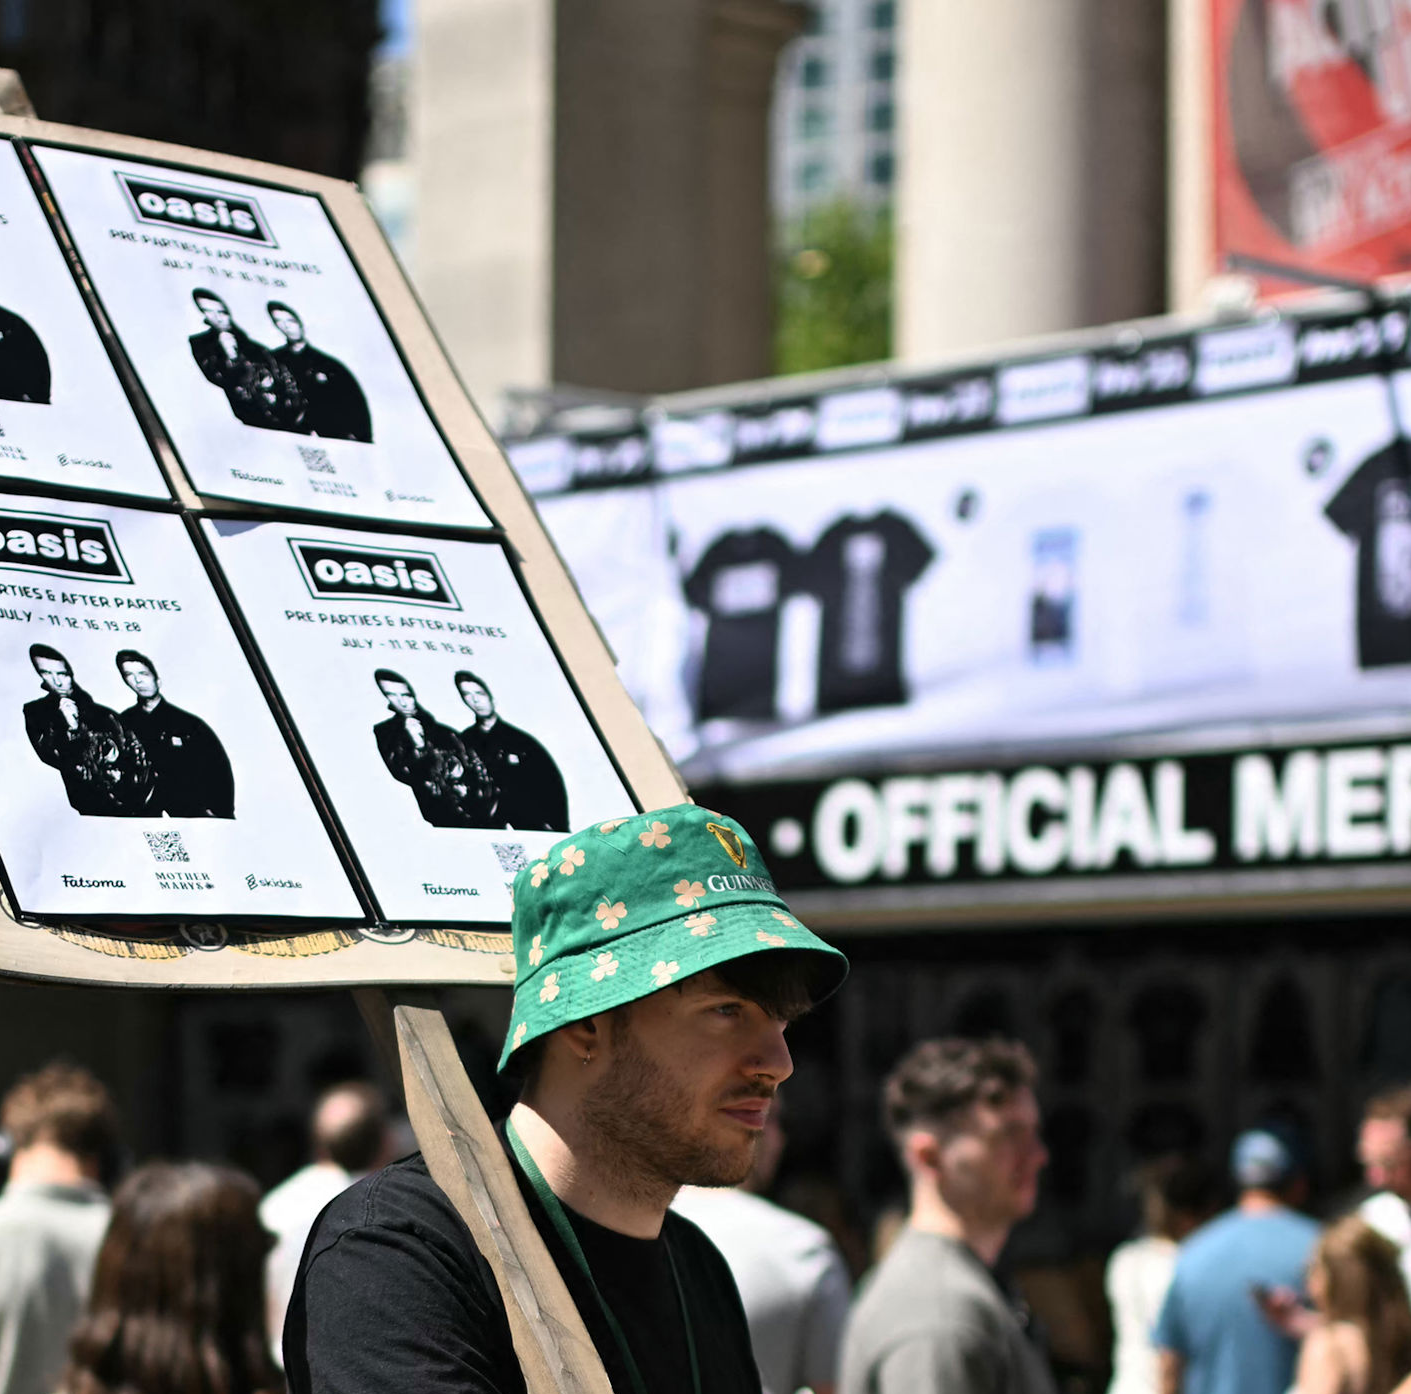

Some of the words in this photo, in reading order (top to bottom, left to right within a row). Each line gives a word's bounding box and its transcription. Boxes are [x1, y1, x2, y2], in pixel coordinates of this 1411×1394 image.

[138, 191, 256, 232] oasis
[314, 558, 438, 593] oasis
[61, 592, 110, 608] AFTER
[114, 597, 182, 612] PARTIES
[284, 609, 316, 623] PRE
[318, 612, 383, 627] PARTIES
[400, 616, 444, 631] AFTER
[447, 622, 508, 638] PARTIES
[341, 637, 373, 649] JULY
[812, 760, 1217, 884] OFFICIAL
[60, 874, 127, 888] Fatsoma
[154, 871, 211, 882] MOTHER
[259, 878, 304, 889] skiddle
[159, 880, 206, 891] MARYS
[422, 882, 481, 897] Fatsoma
